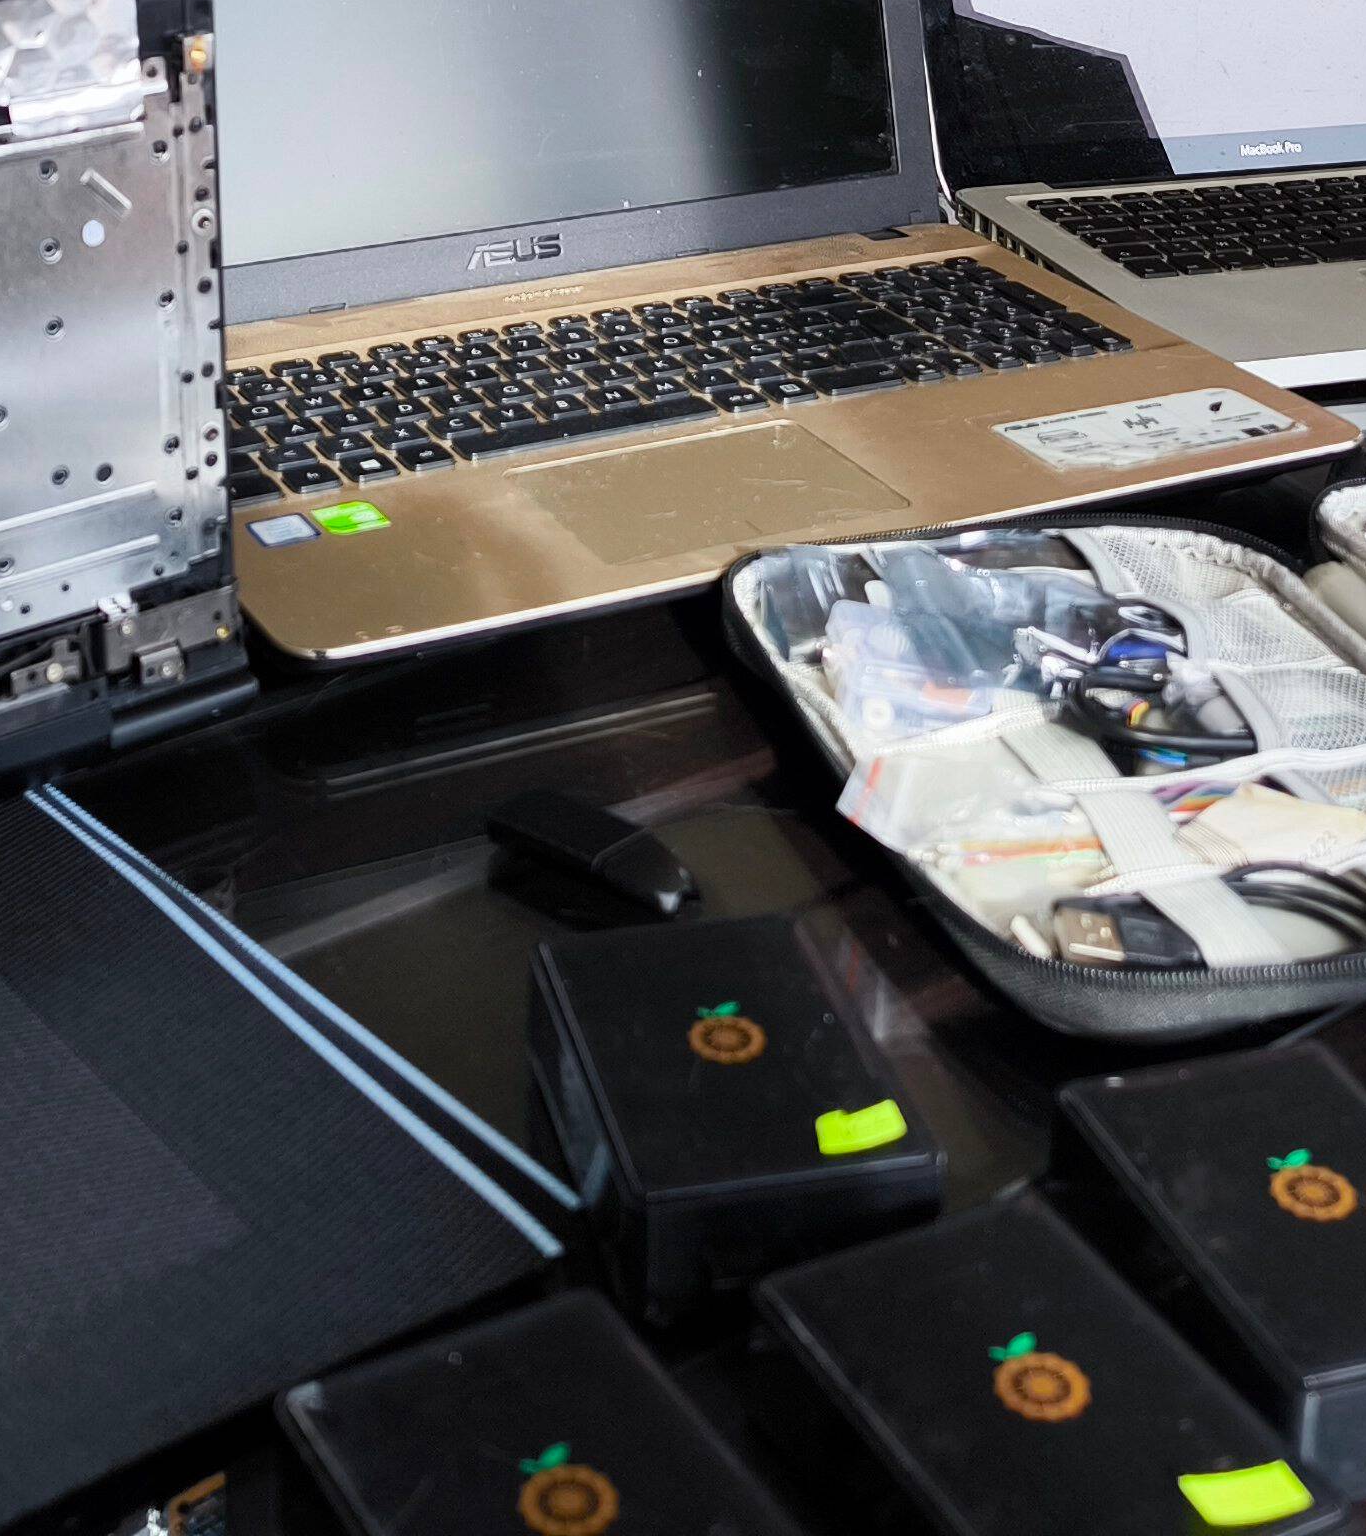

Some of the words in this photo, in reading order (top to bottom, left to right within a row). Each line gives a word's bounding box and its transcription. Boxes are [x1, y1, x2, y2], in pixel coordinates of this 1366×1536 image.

[1240, 141, 1284, 157] MacBook
[1284, 141, 1302, 154] Pro
[466, 233, 563, 270] ASUS
